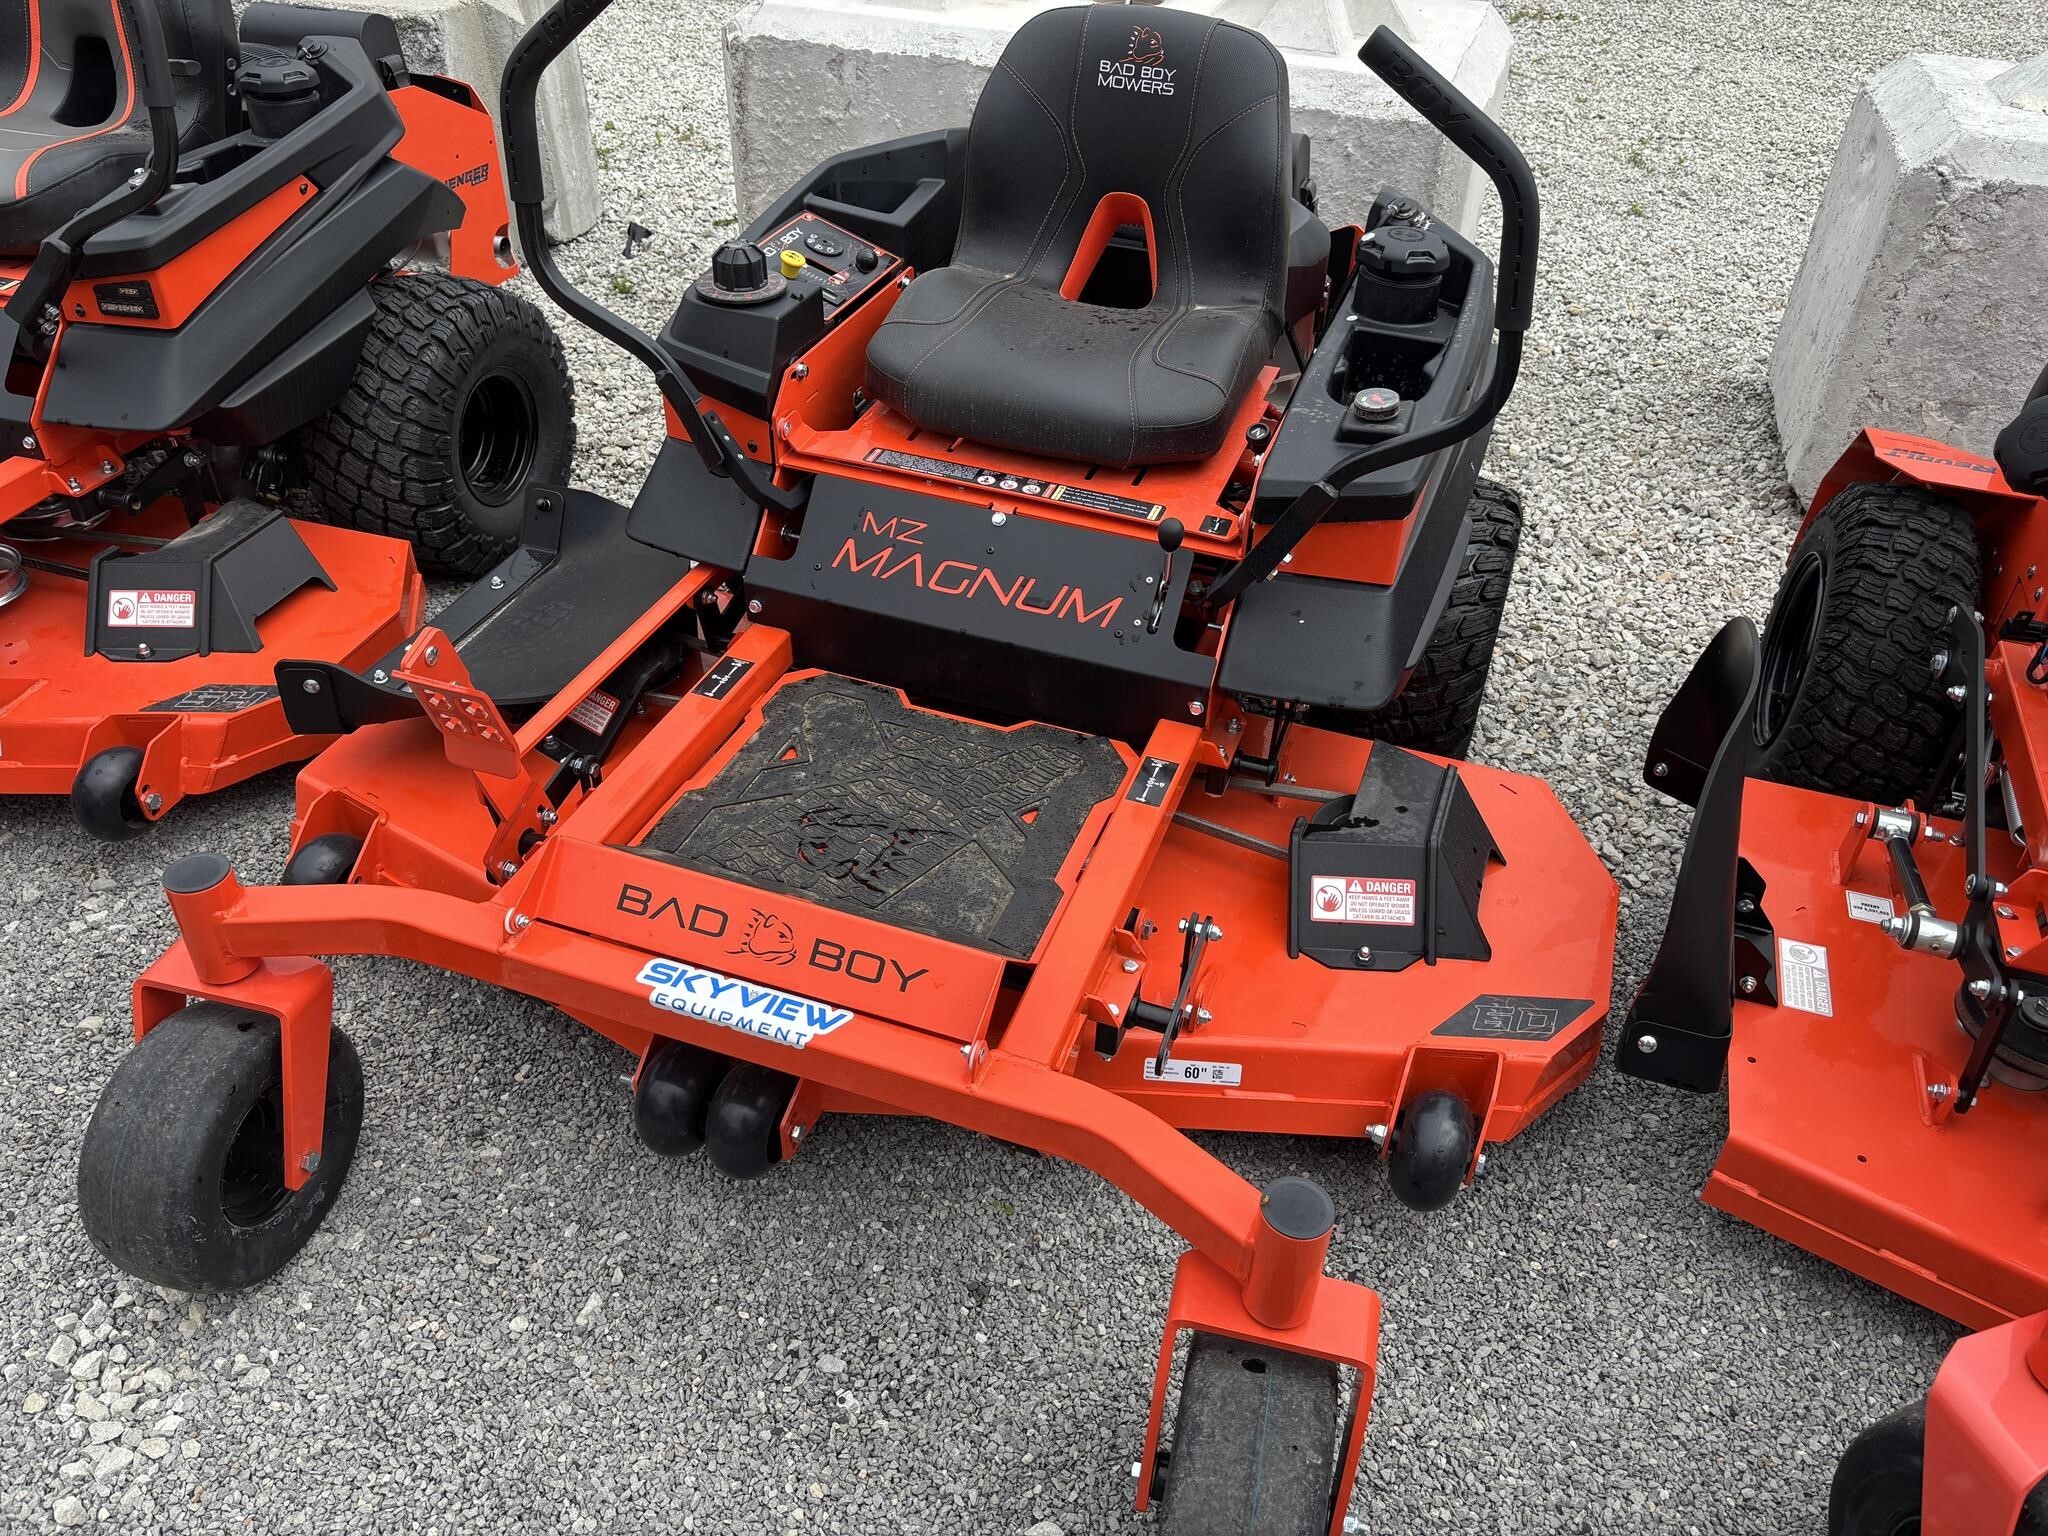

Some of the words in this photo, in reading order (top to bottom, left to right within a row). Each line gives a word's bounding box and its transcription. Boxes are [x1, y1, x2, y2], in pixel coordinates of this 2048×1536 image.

[1099, 59, 1136, 76] BAD
[1140, 66, 1177, 82] BOY
[1097, 73, 1175, 96] MOWERS
[444, 163, 489, 189] ENGER
[862, 510, 929, 546] MZ
[830, 536, 1125, 629] MAGNUM
[154, 593, 192, 603] DANGER
[588, 690, 616, 711] ANGER
[1366, 881, 1412, 894] DANGER
[616, 883, 729, 939] BAD
[808, 938, 930, 993] BOY
[643, 961, 848, 1031] SKYVIEW
[1814, 980, 1829, 1013] DANGER
[654, 992, 808, 1047] EQUIPMENT
[1184, 1066, 1208, 1080] 60"
